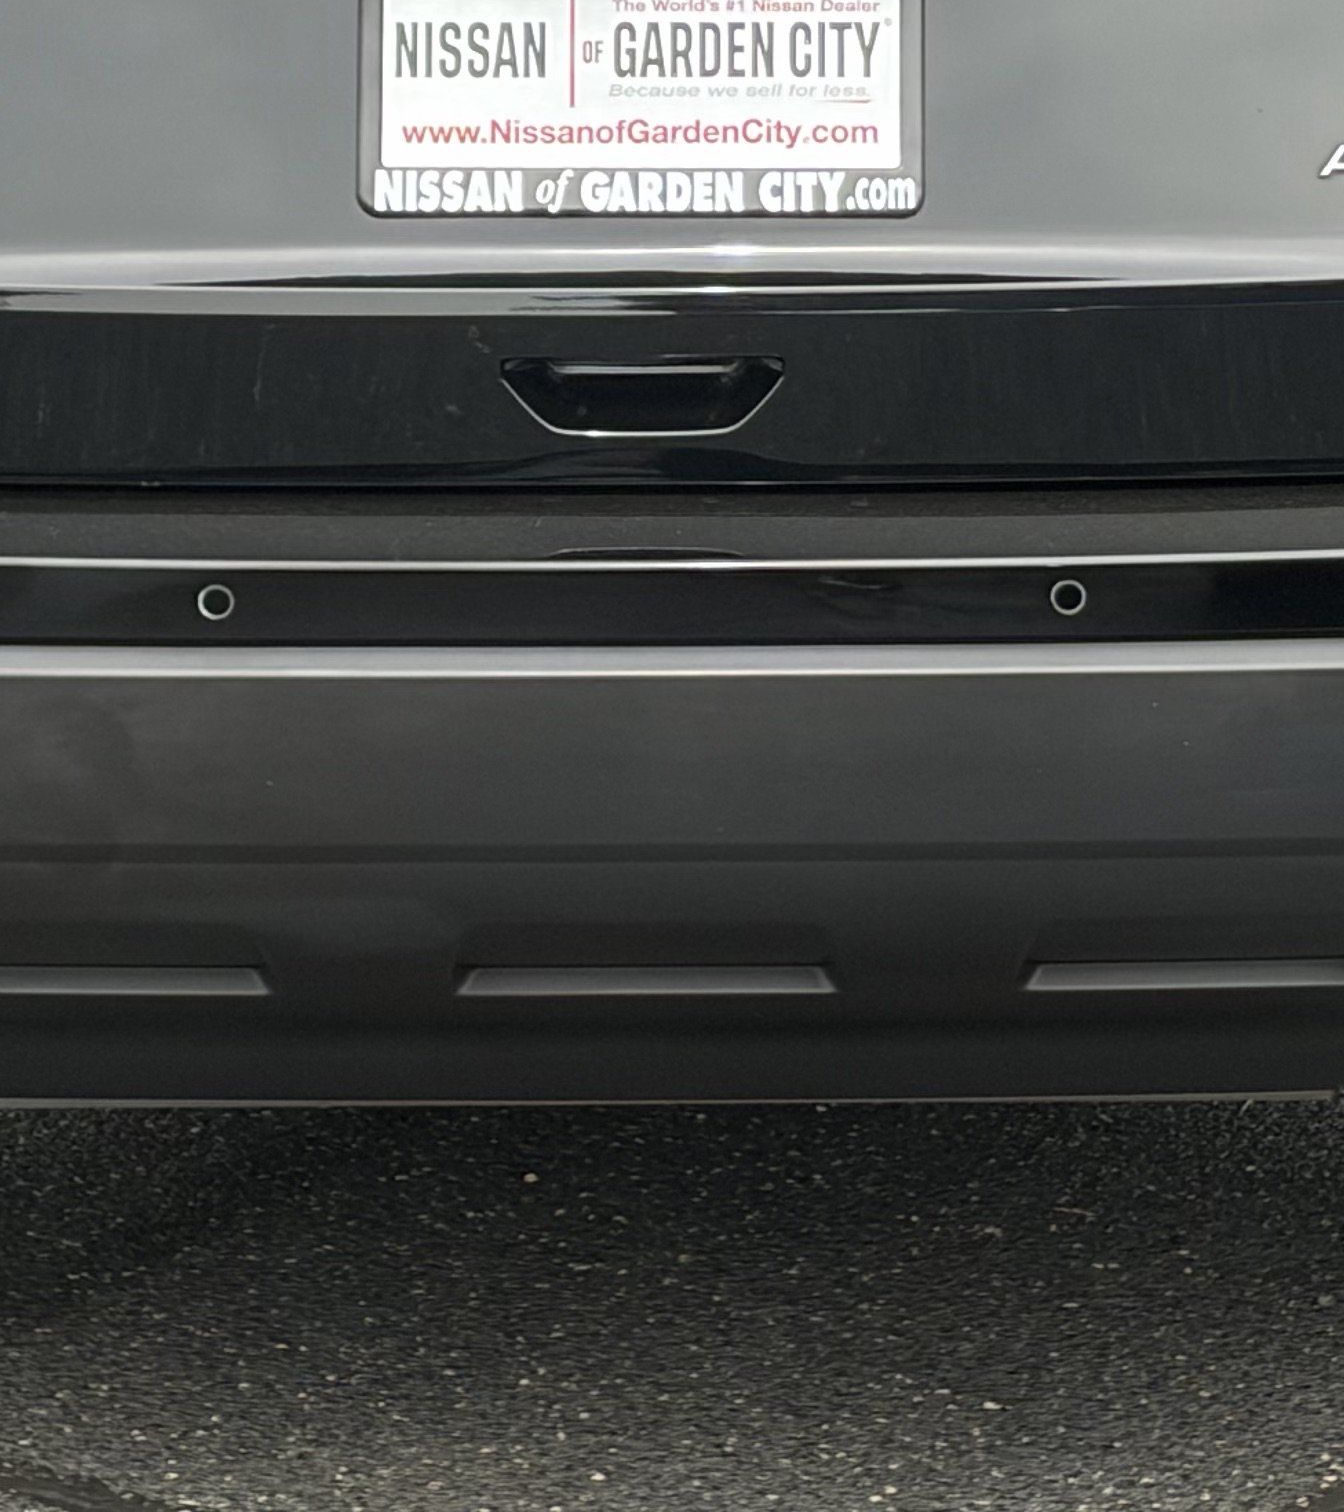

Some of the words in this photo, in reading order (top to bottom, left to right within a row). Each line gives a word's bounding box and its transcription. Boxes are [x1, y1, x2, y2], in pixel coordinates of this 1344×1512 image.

[394, 22, 546, 79] NISSAN
[582, 40, 604, 64] OF
[613, 21, 775, 78] GARDEN
[789, 21, 881, 78] CITY
[608, 83, 701, 98] Because
[707, 86, 739, 98] we
[745, 83, 782, 98] sell
[788, 83, 818, 98] for
[402, 118, 879, 149] www.NissanofGardenCity.com
[373, 170, 523, 213] NISSAN
[535, 168, 574, 214] of
[579, 171, 744, 213] GARDEN
[758, 171, 917, 213] CITY.com
